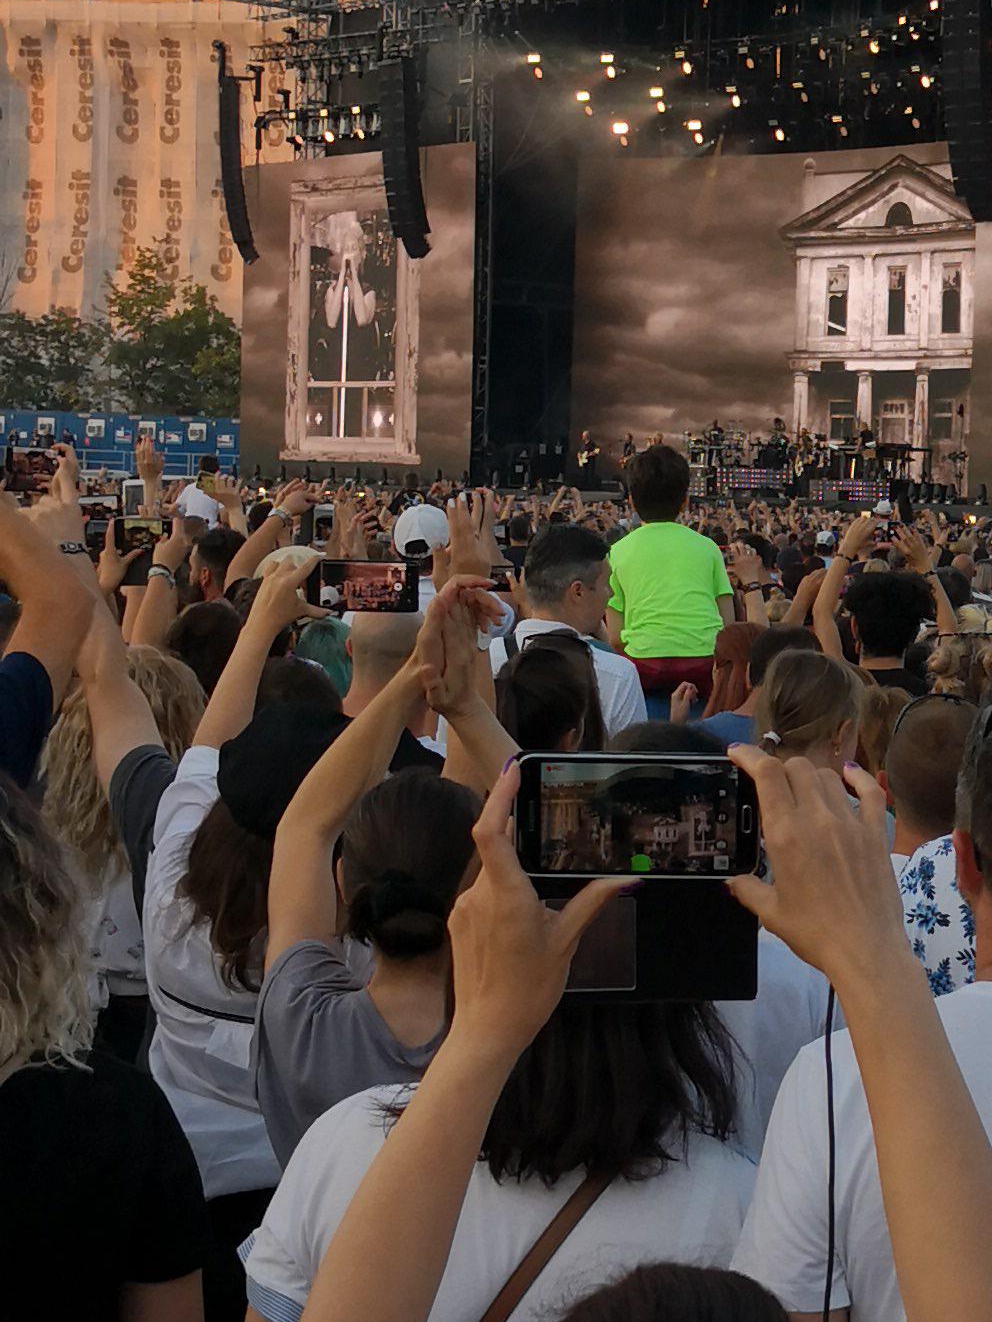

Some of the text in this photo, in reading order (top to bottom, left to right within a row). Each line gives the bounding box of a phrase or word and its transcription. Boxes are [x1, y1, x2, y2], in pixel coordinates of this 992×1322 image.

[19, 35, 45, 144] Ceresit
[70, 35, 94, 142] Ceresit
[159, 37, 182, 144] Ceresit
[18, 178, 43, 284] Ceresit
[61, 169, 91, 274] Ceresit
[113, 174, 138, 271] eresit
